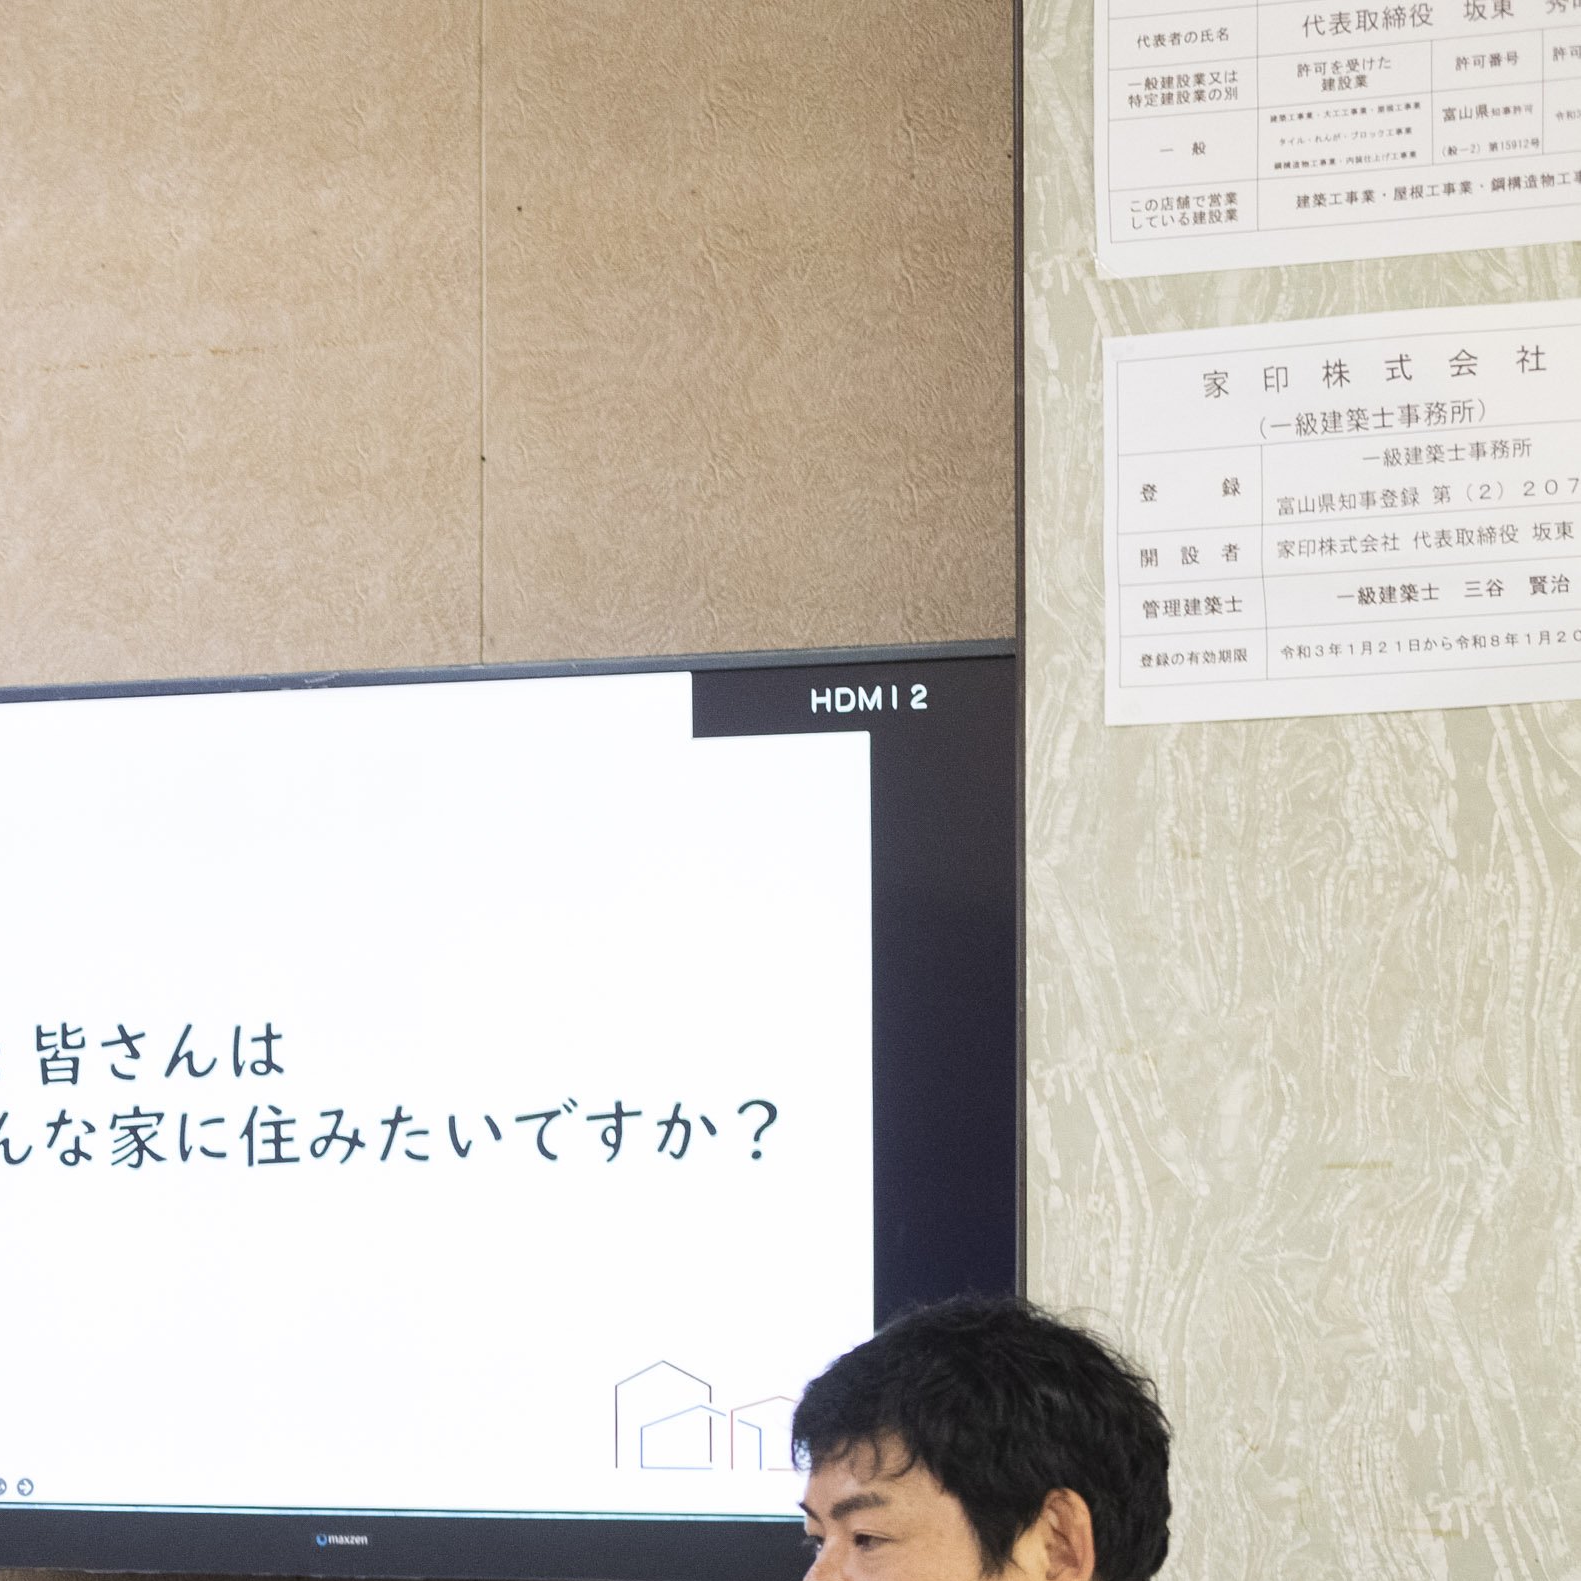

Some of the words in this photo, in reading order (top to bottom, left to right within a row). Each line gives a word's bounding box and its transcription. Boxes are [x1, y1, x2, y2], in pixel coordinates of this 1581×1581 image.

[1302, 4, 1434, 38] 代表取締役
[1137, 28, 1229, 49] 代表者の氏名
[1297, 56, 1391, 78] 許可を受けた
[1455, 51, 1519, 72] 許可番号
[1128, 70, 1238, 91] 一般建設業又は
[1321, 75, 1368, 94] 建設業
[1128, 87, 1238, 109] 特定建設業の別
[1130, 191, 1238, 213] この店舗で営業
[1132, 208, 1238, 230] している建設業
[1260, 398, 1487, 440] (一級建築士事務所)
[1362, 438, 1533, 468] 一級建築士事務所
[1277, 486, 1421, 516] 富山県知事登録
[1277, 532, 1400, 560] 家印株式会社
[1413, 524, 1520, 550] 代表取締役
[1532, 520, 1575, 542] 坂東
[1337, 583, 1440, 606] 一級建築士
[1463, 578, 1505, 598] 三谷
[1529, 574, 1571, 595] 賢治
[1142, 595, 1244, 620] 管理建築士
[1140, 647, 1248, 669] 登録の有効期限
[811, 685, 898, 714] HDMI
[910, 683, 928, 710] 2
[328, 1534, 368, 1546] maxzen
